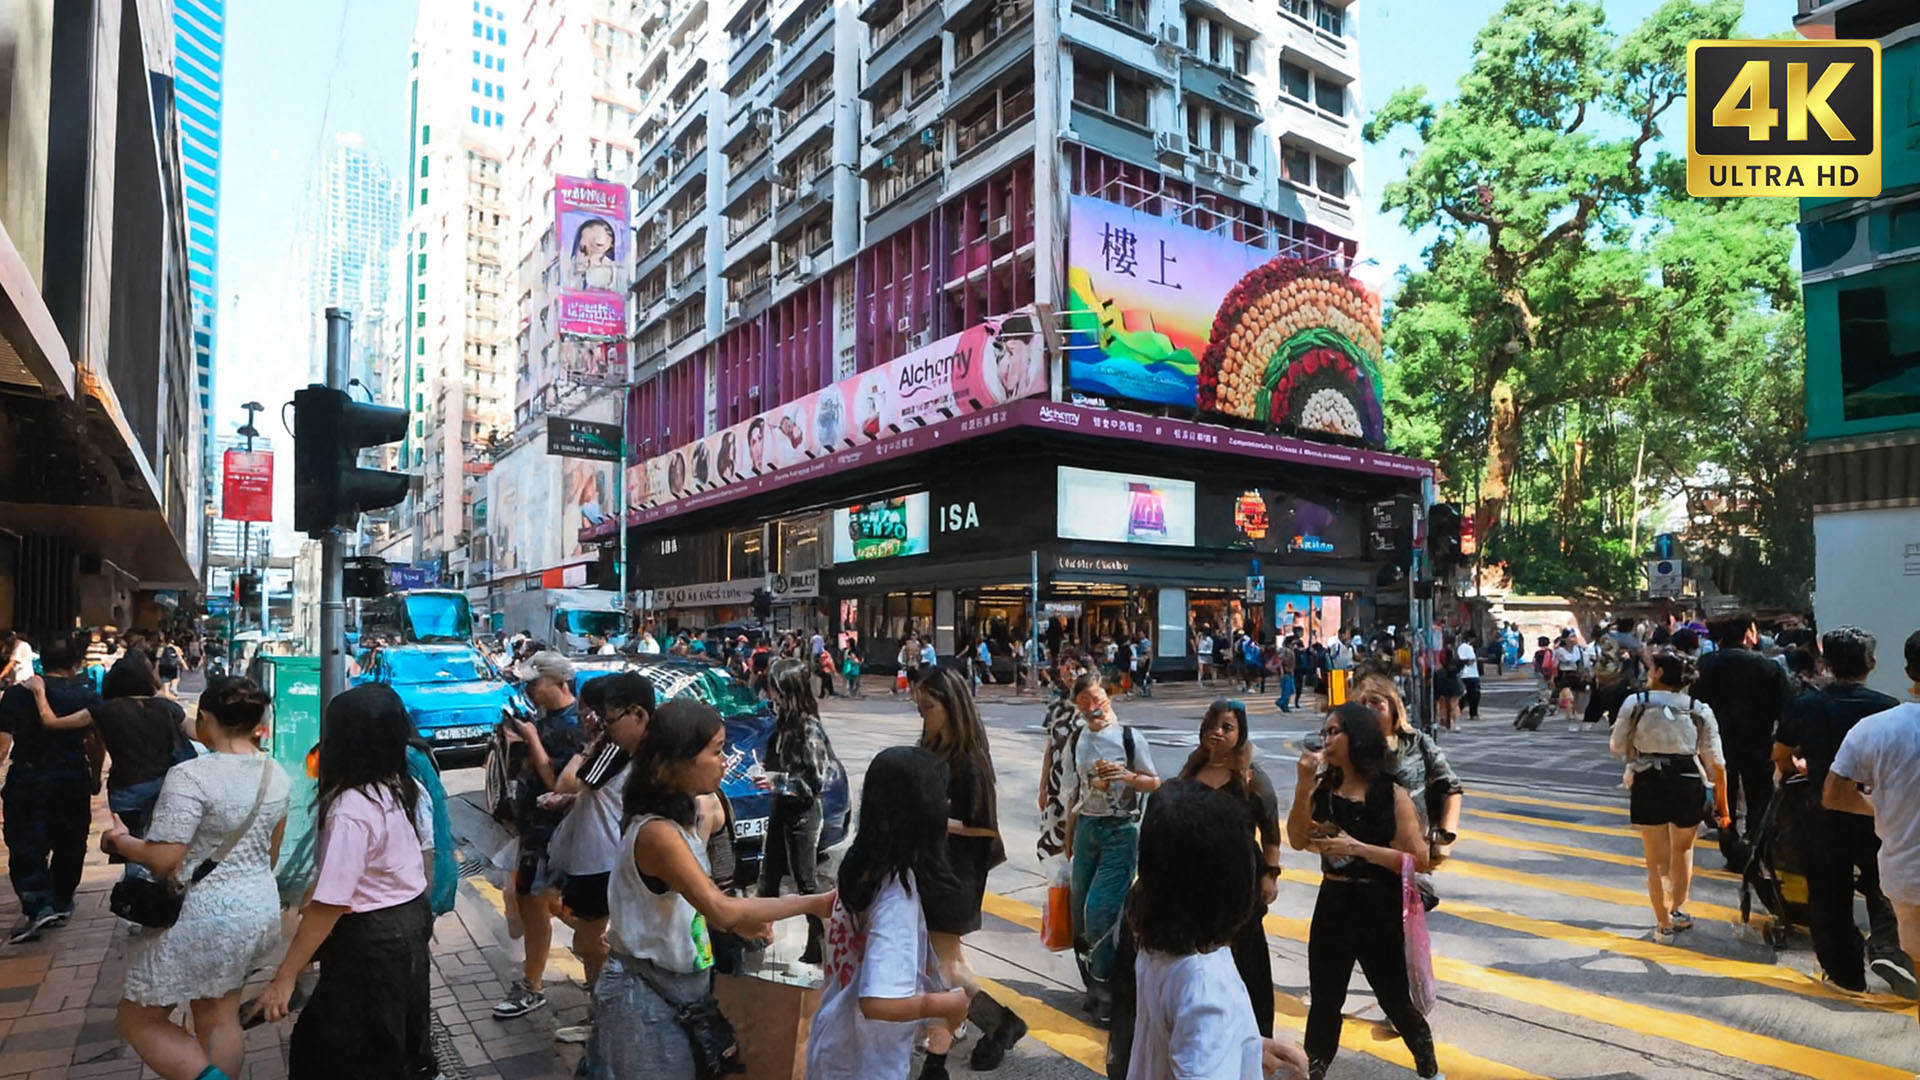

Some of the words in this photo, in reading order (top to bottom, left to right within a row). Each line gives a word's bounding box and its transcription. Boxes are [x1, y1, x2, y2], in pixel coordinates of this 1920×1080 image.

[1097, 221, 1183, 291] 樓上
[940, 501, 980, 533] ISA
[735, 821, 752, 836] CP
